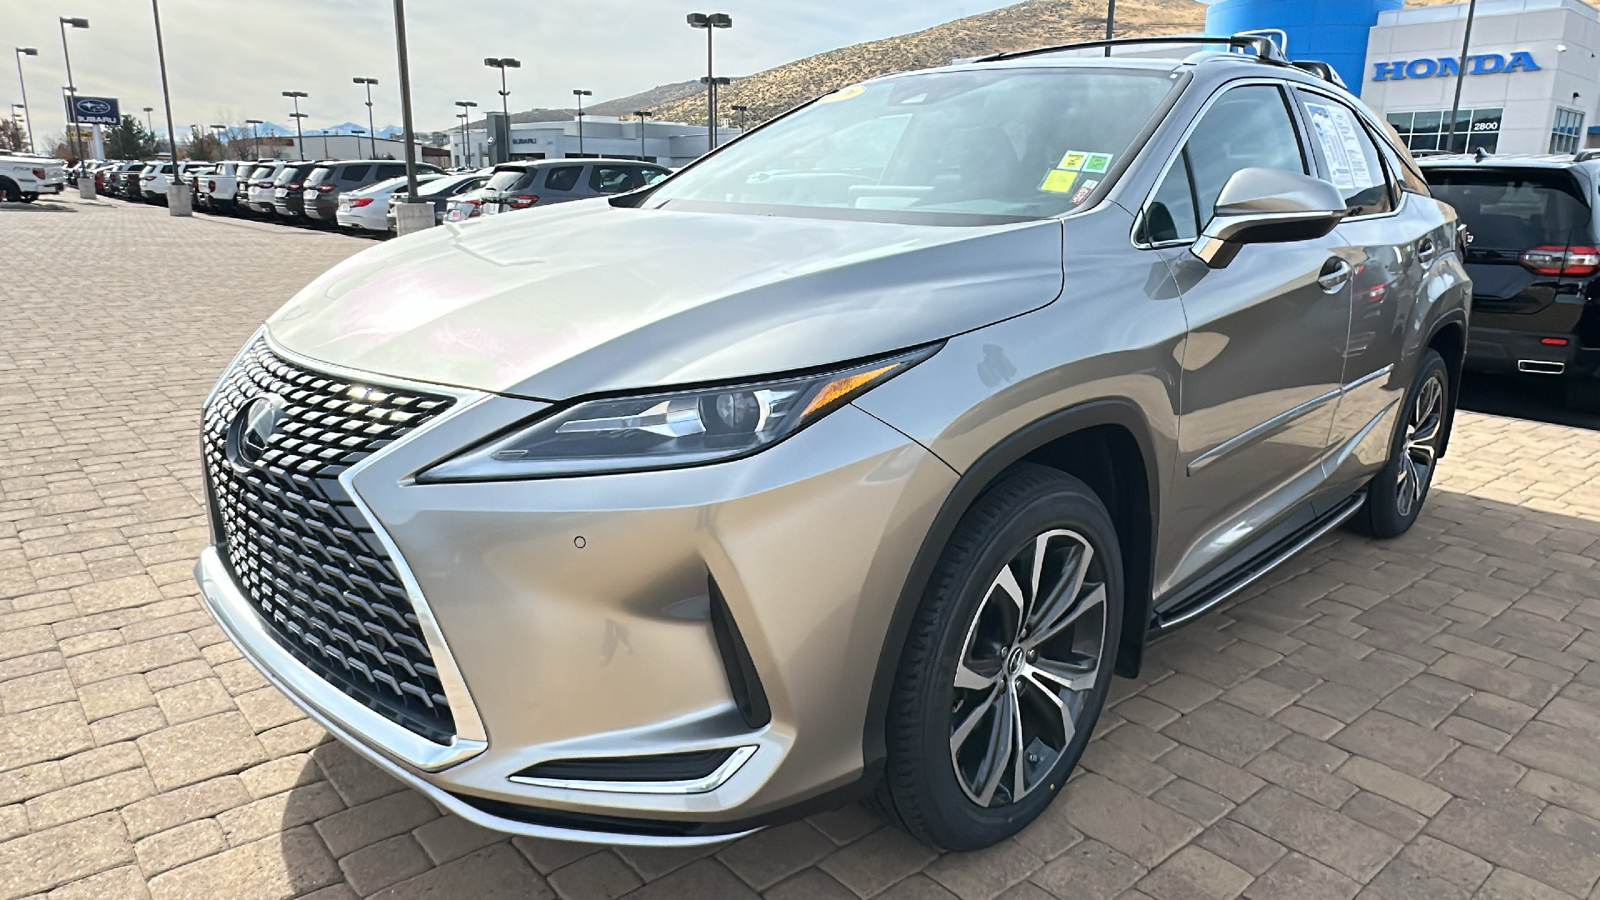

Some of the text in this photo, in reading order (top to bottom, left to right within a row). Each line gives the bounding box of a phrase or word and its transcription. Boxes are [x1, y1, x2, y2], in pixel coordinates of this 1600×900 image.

[1372, 51, 1542, 82] HONDA
[77, 115, 117, 124] SUBARU
[1473, 121, 1498, 131] 2800
